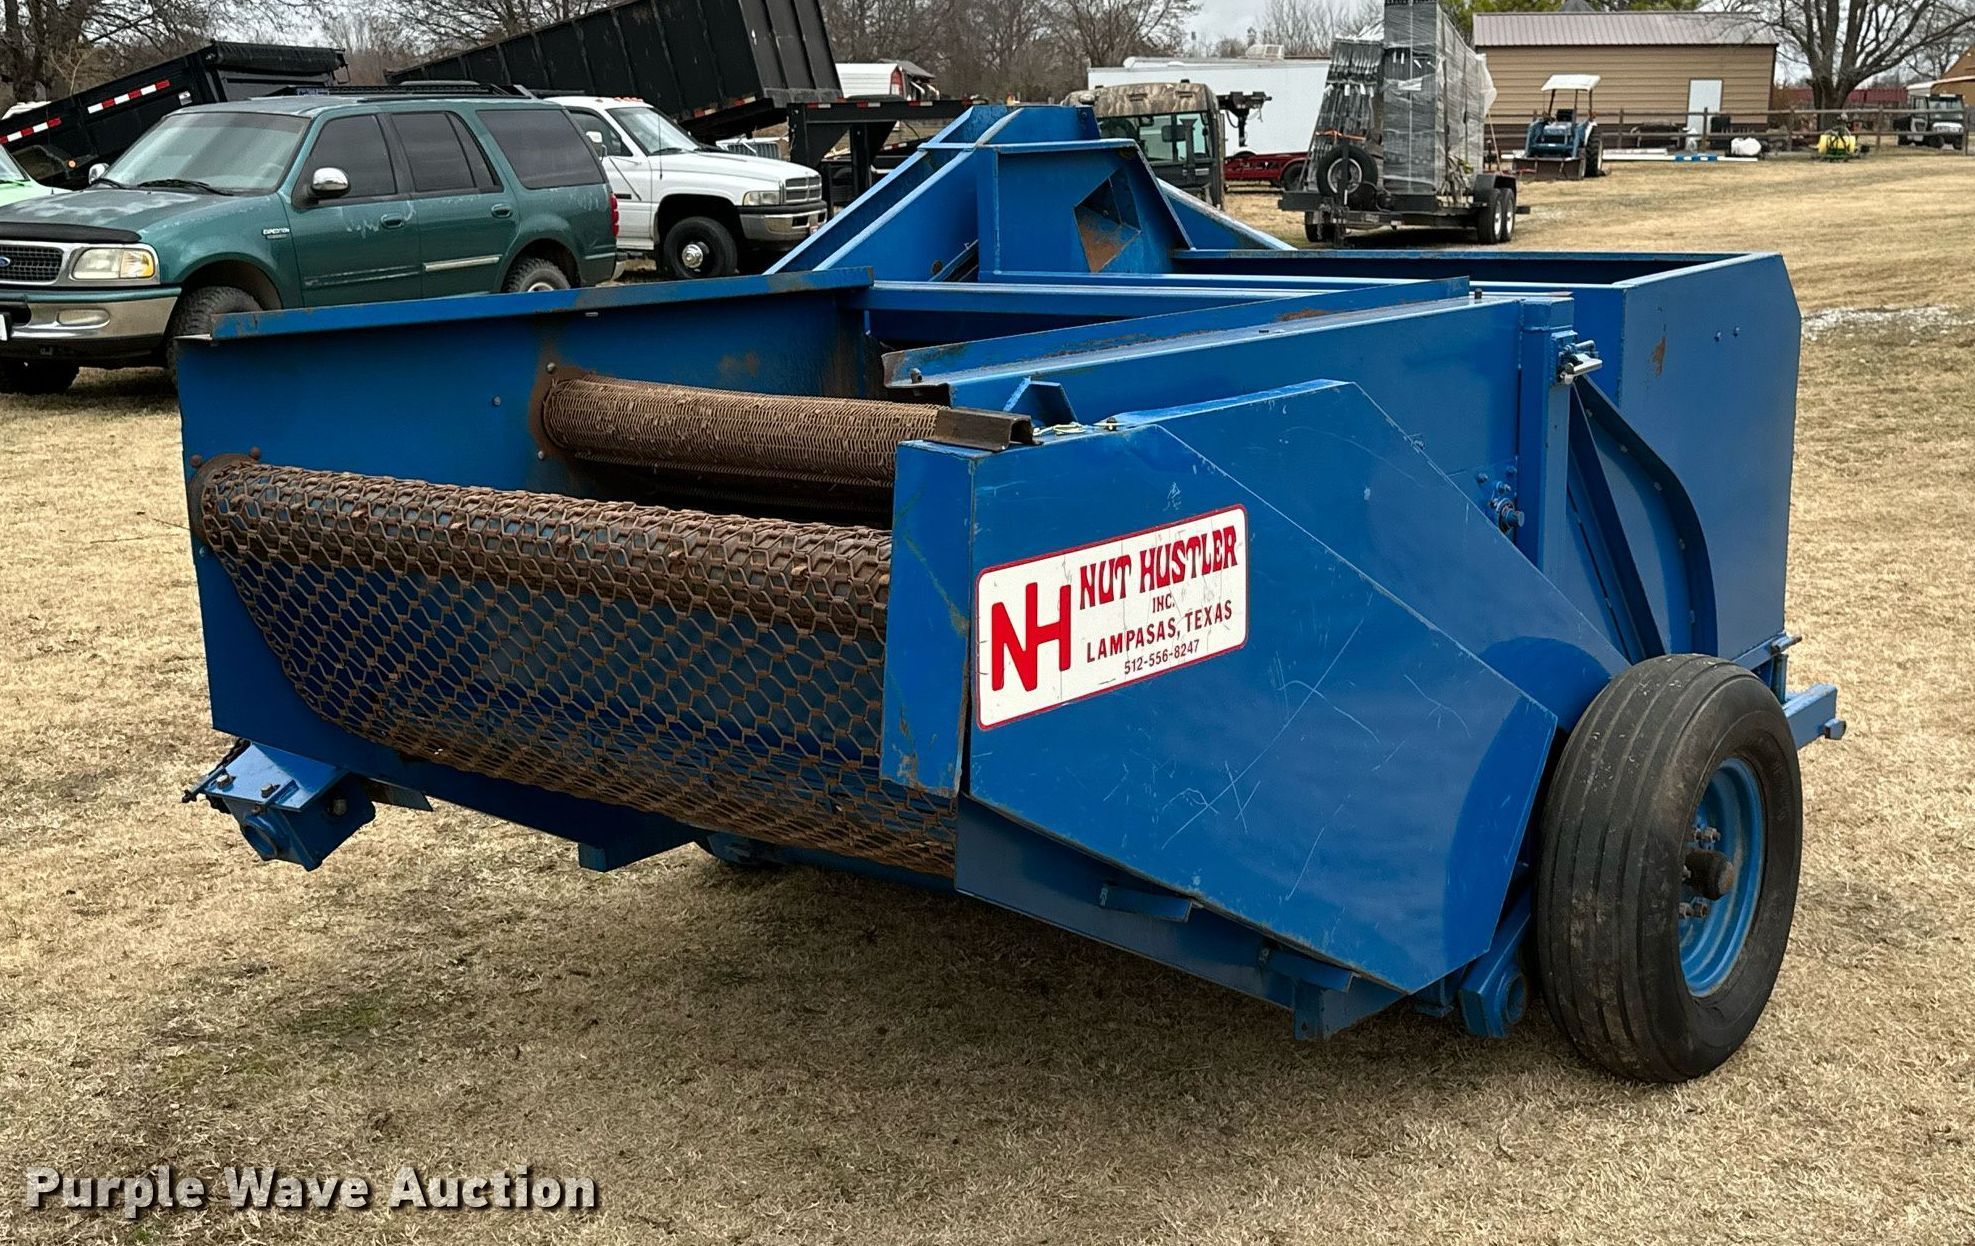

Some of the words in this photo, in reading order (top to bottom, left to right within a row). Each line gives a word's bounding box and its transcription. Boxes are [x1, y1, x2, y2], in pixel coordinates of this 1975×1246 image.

[1079, 554, 1132, 610] NUT
[1139, 525, 1238, 593] HUSTLER
[1087, 617, 1181, 663] LAMPASAS,
[1185, 600, 1232, 633] TEXAS
[1152, 593, 1175, 613] INC.
[992, 582, 1072, 692] NH
[1124, 639, 1200, 675] 512-556-8247
